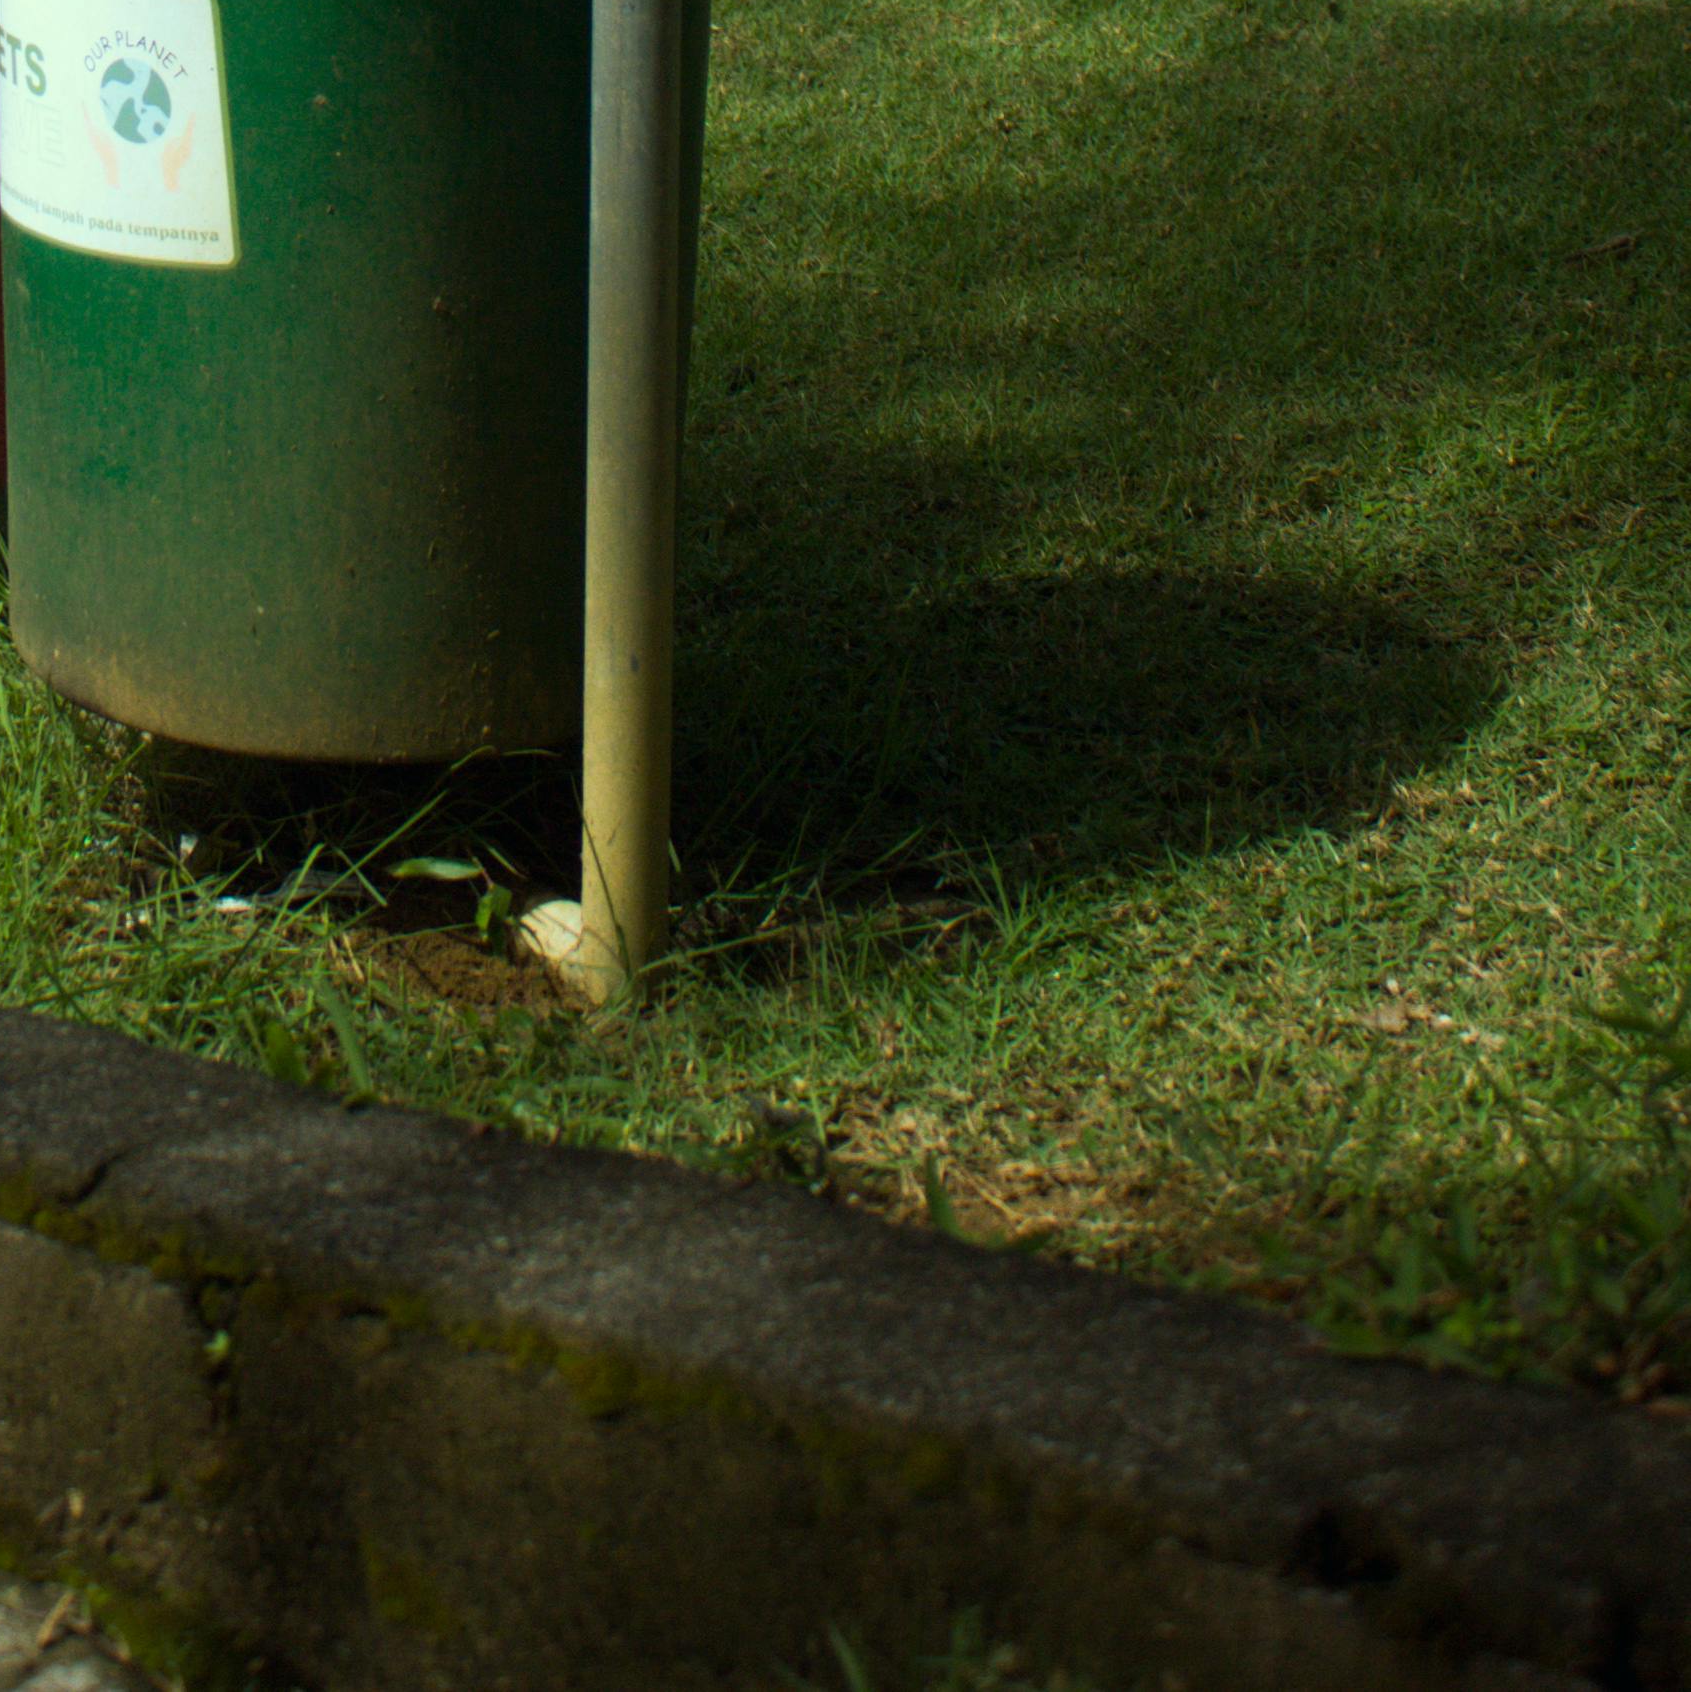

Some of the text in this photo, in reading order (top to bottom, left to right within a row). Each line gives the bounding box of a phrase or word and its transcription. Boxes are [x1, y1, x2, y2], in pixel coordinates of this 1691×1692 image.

[84, 30, 188, 78] OUR PLANET
[89, 217, 123, 233] pada
[128, 222, 220, 244] tempatnya
